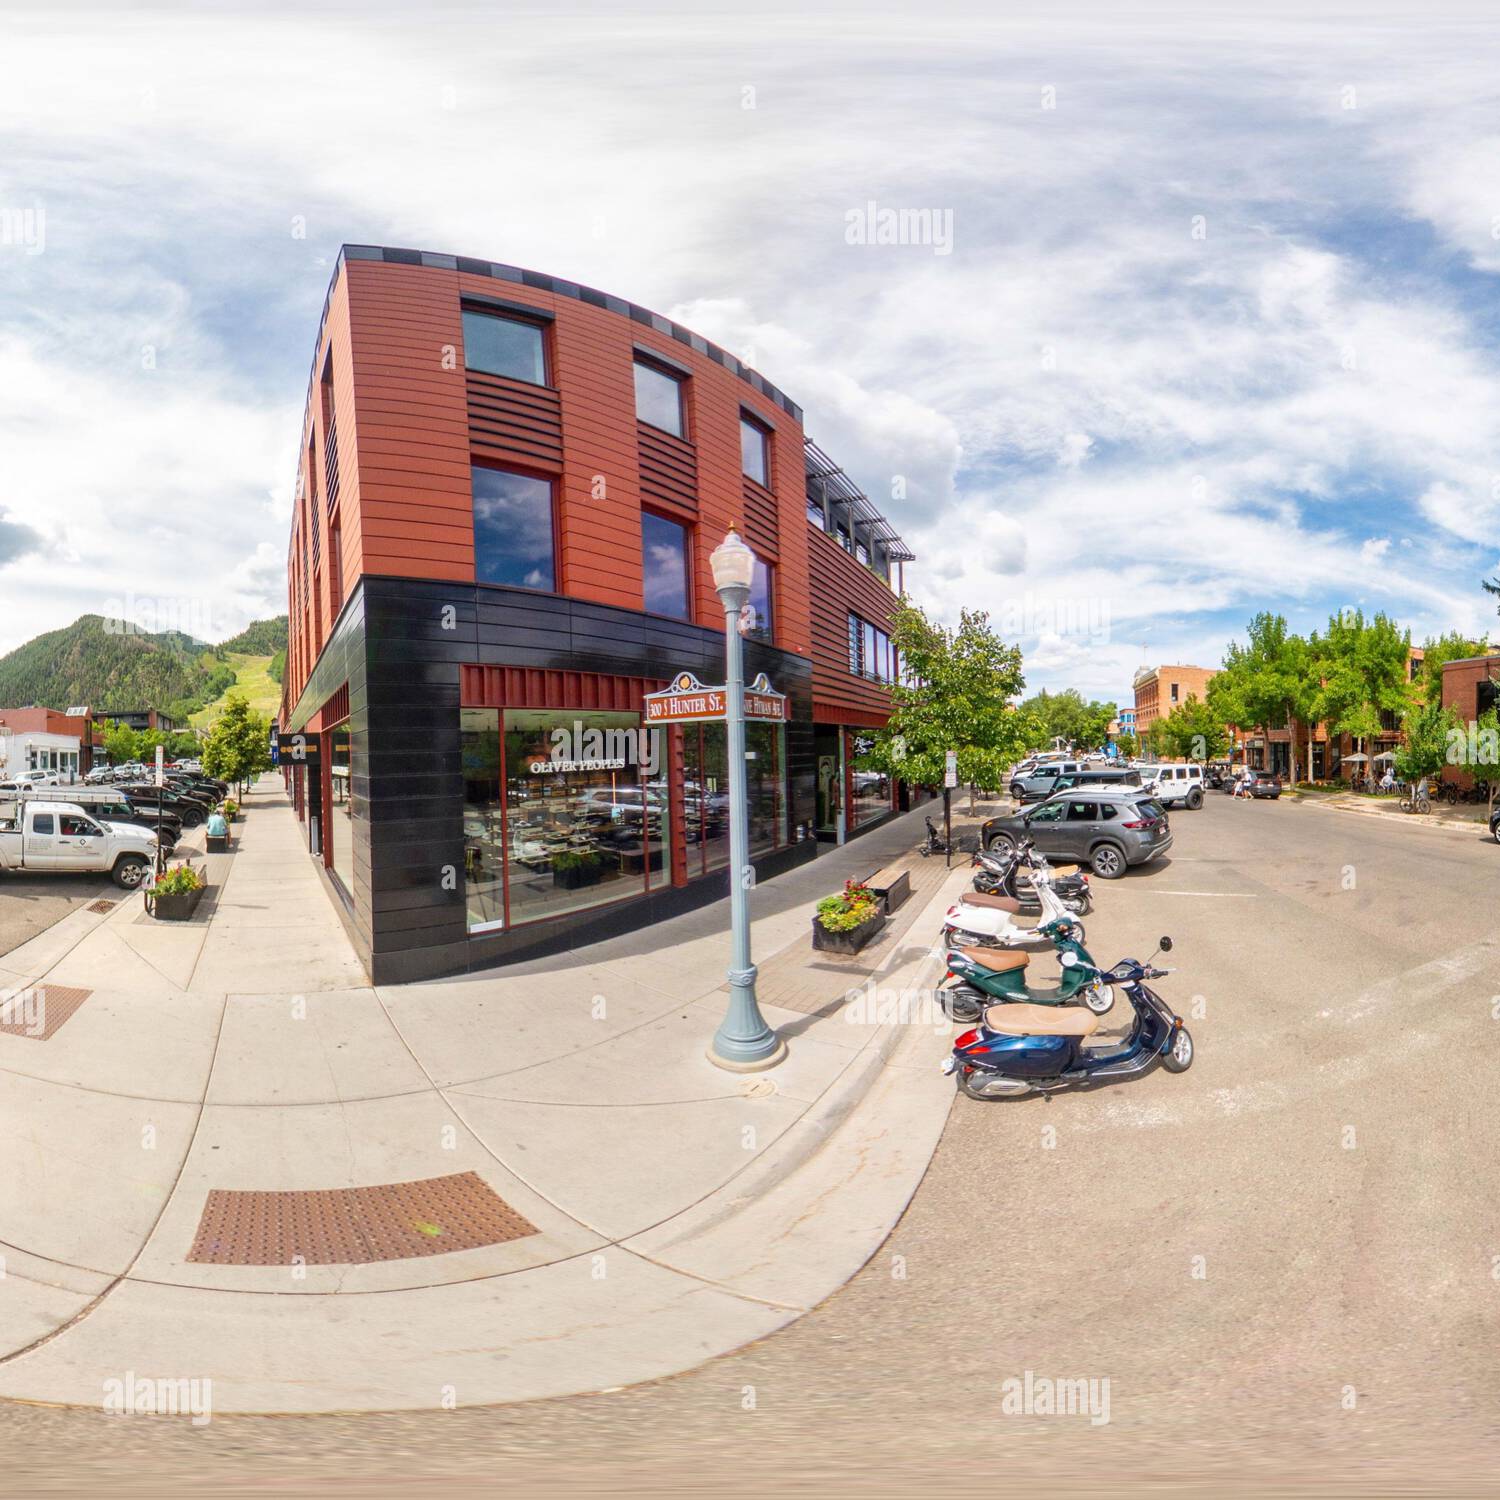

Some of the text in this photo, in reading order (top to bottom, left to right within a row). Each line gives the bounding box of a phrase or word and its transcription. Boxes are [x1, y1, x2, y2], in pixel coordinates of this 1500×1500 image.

[649, 703, 662, 717] 300
[669, 697, 706, 715] HUNTER
[708, 693, 724, 711] ST.
[530, 758, 625, 773] OLIVER PEOPLES
